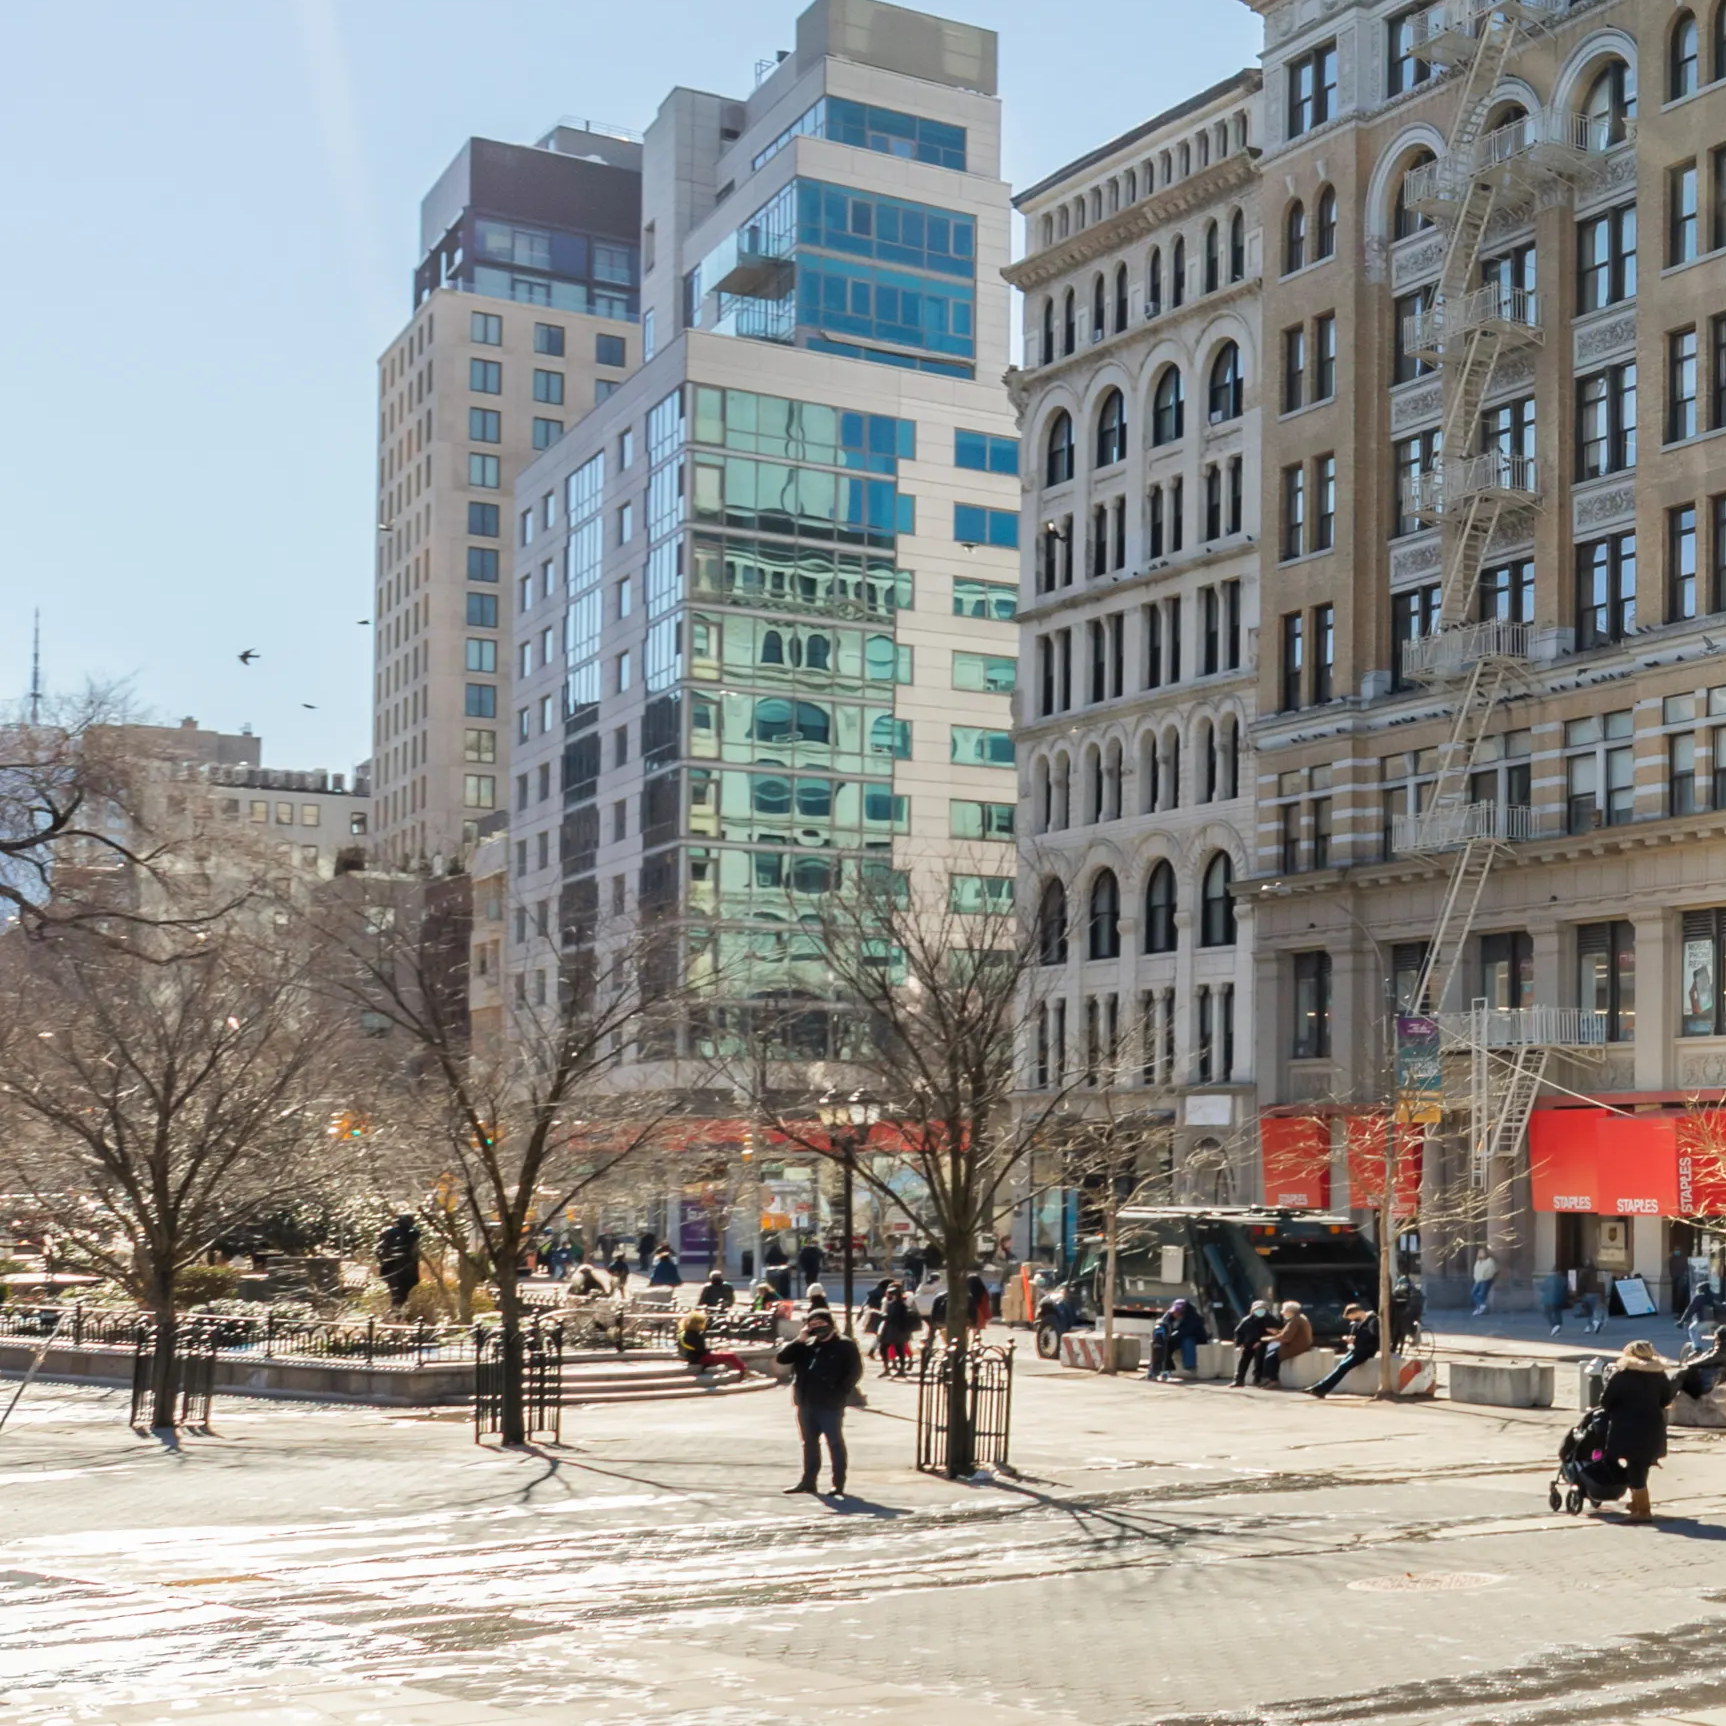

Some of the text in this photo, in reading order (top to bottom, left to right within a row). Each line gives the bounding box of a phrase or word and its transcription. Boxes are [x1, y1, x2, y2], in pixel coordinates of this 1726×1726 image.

[1679, 1156, 1693, 1214] STAPLES
[1553, 1195, 1592, 1210] STAPLES
[1616, 1198, 1659, 1214] STAPLES
